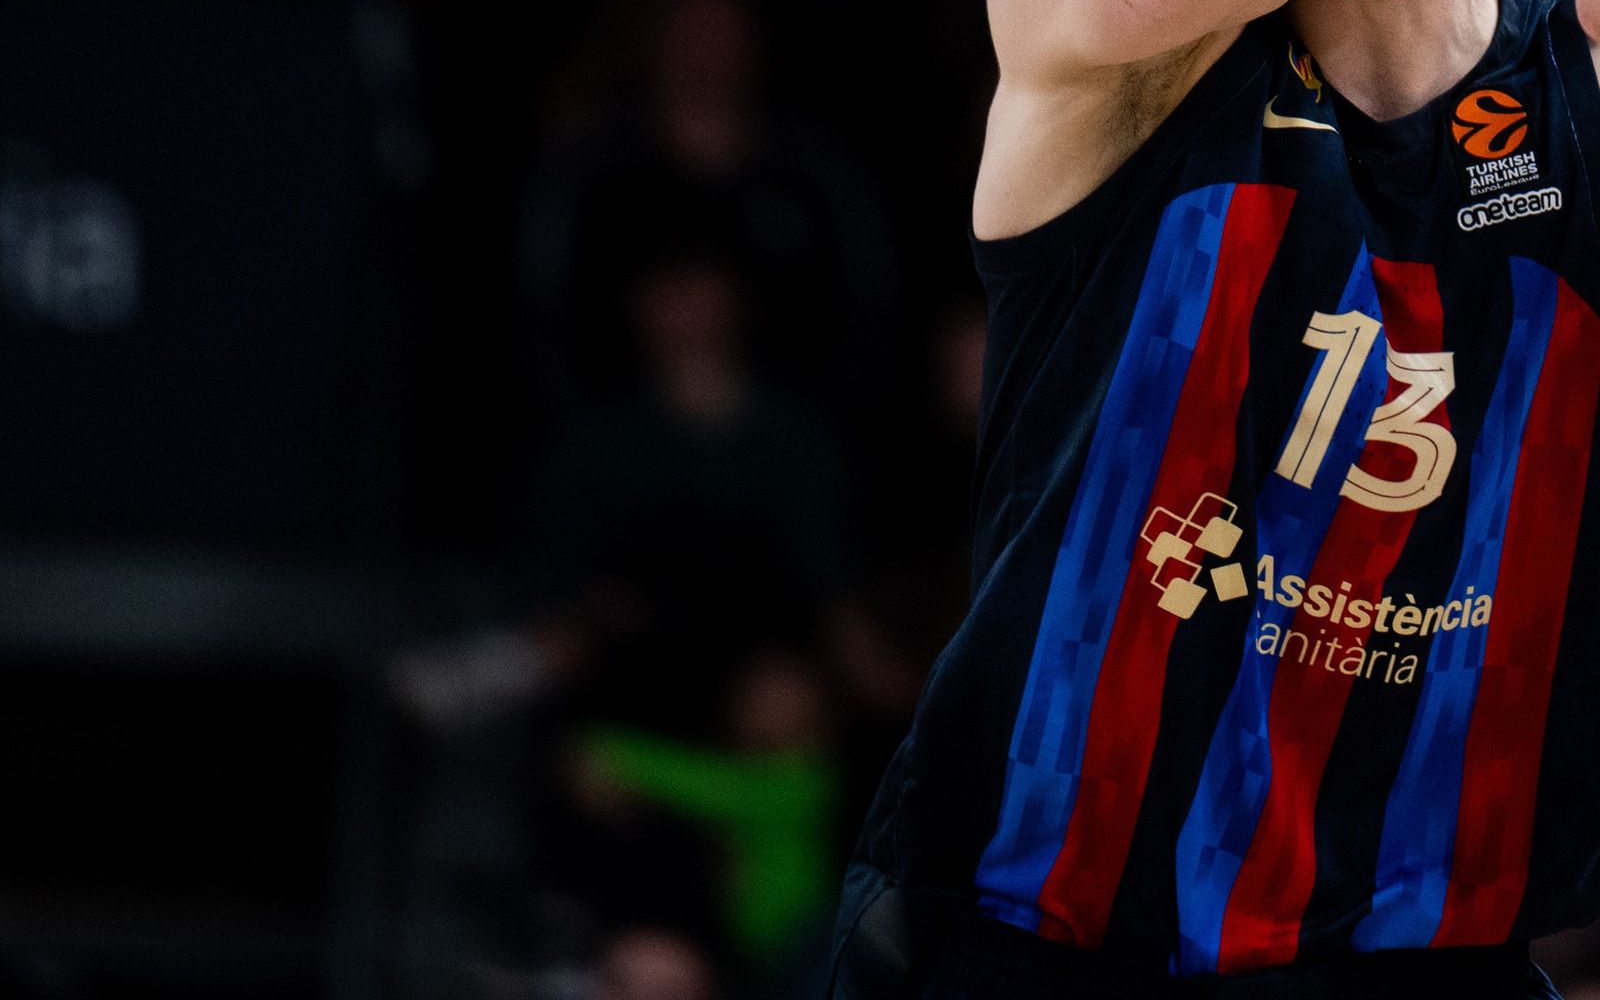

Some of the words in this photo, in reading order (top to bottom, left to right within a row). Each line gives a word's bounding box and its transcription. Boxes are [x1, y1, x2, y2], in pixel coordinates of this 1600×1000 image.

[1465, 151, 1536, 178] TURKISH
[1470, 162, 1538, 189] AIRLINES
[1457, 186, 1562, 231] oneteam
[1274, 309, 1457, 512] 13
[1257, 554, 1493, 637] Assistència
[1255, 610, 1418, 684] anitària
